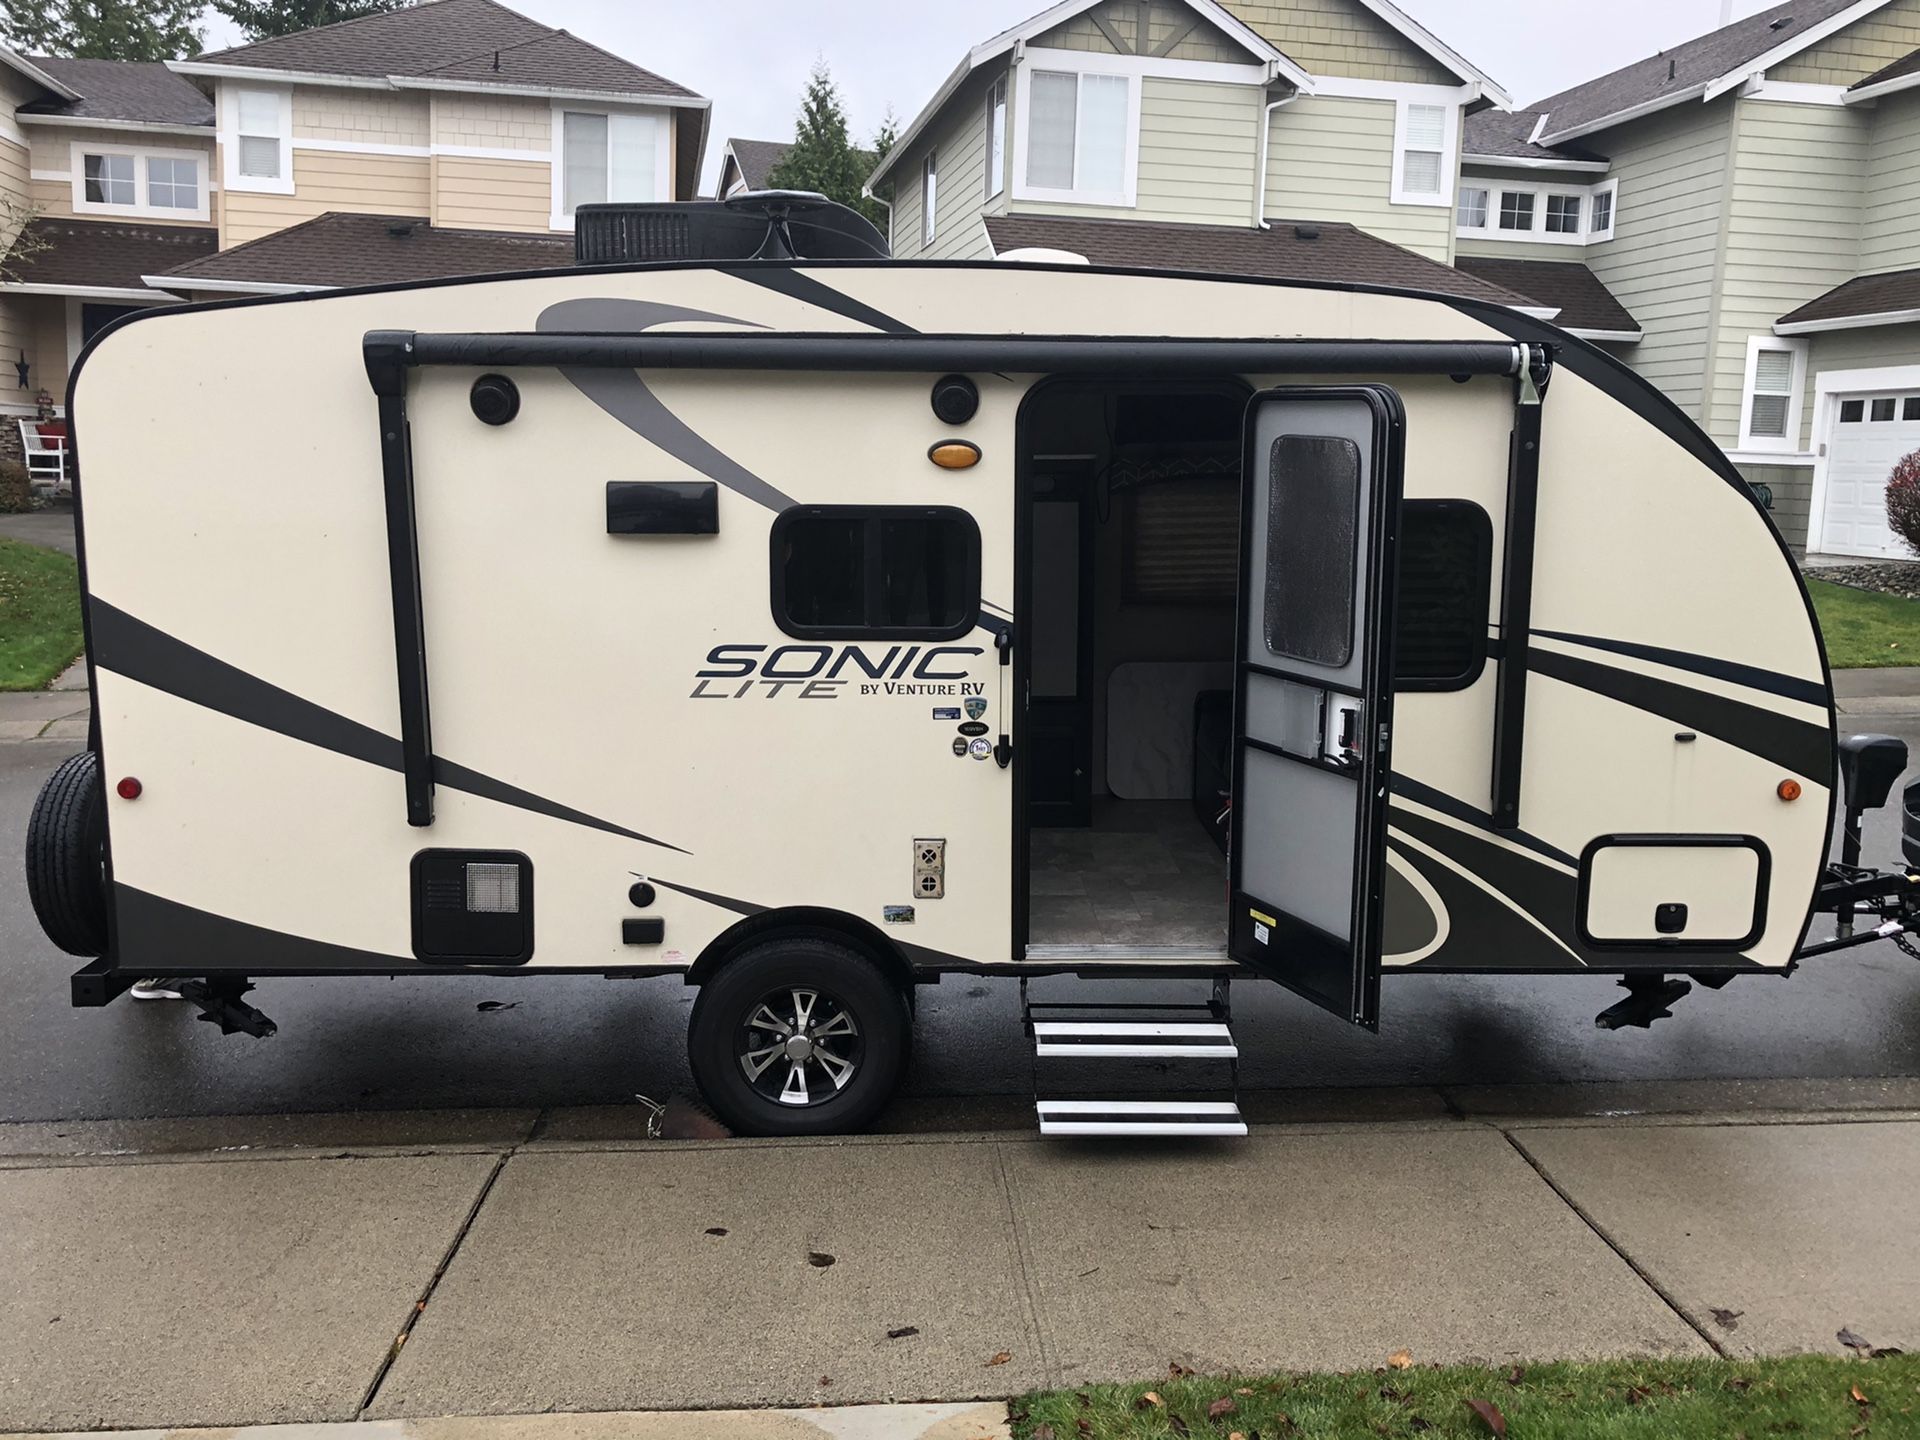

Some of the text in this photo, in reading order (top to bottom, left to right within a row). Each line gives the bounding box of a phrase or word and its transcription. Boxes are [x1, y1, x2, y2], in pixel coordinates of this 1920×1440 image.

[695, 645, 984, 680] SONIC
[689, 679, 849, 699] LITE
[860, 684, 880, 696] BY
[959, 683, 986, 696] RV
